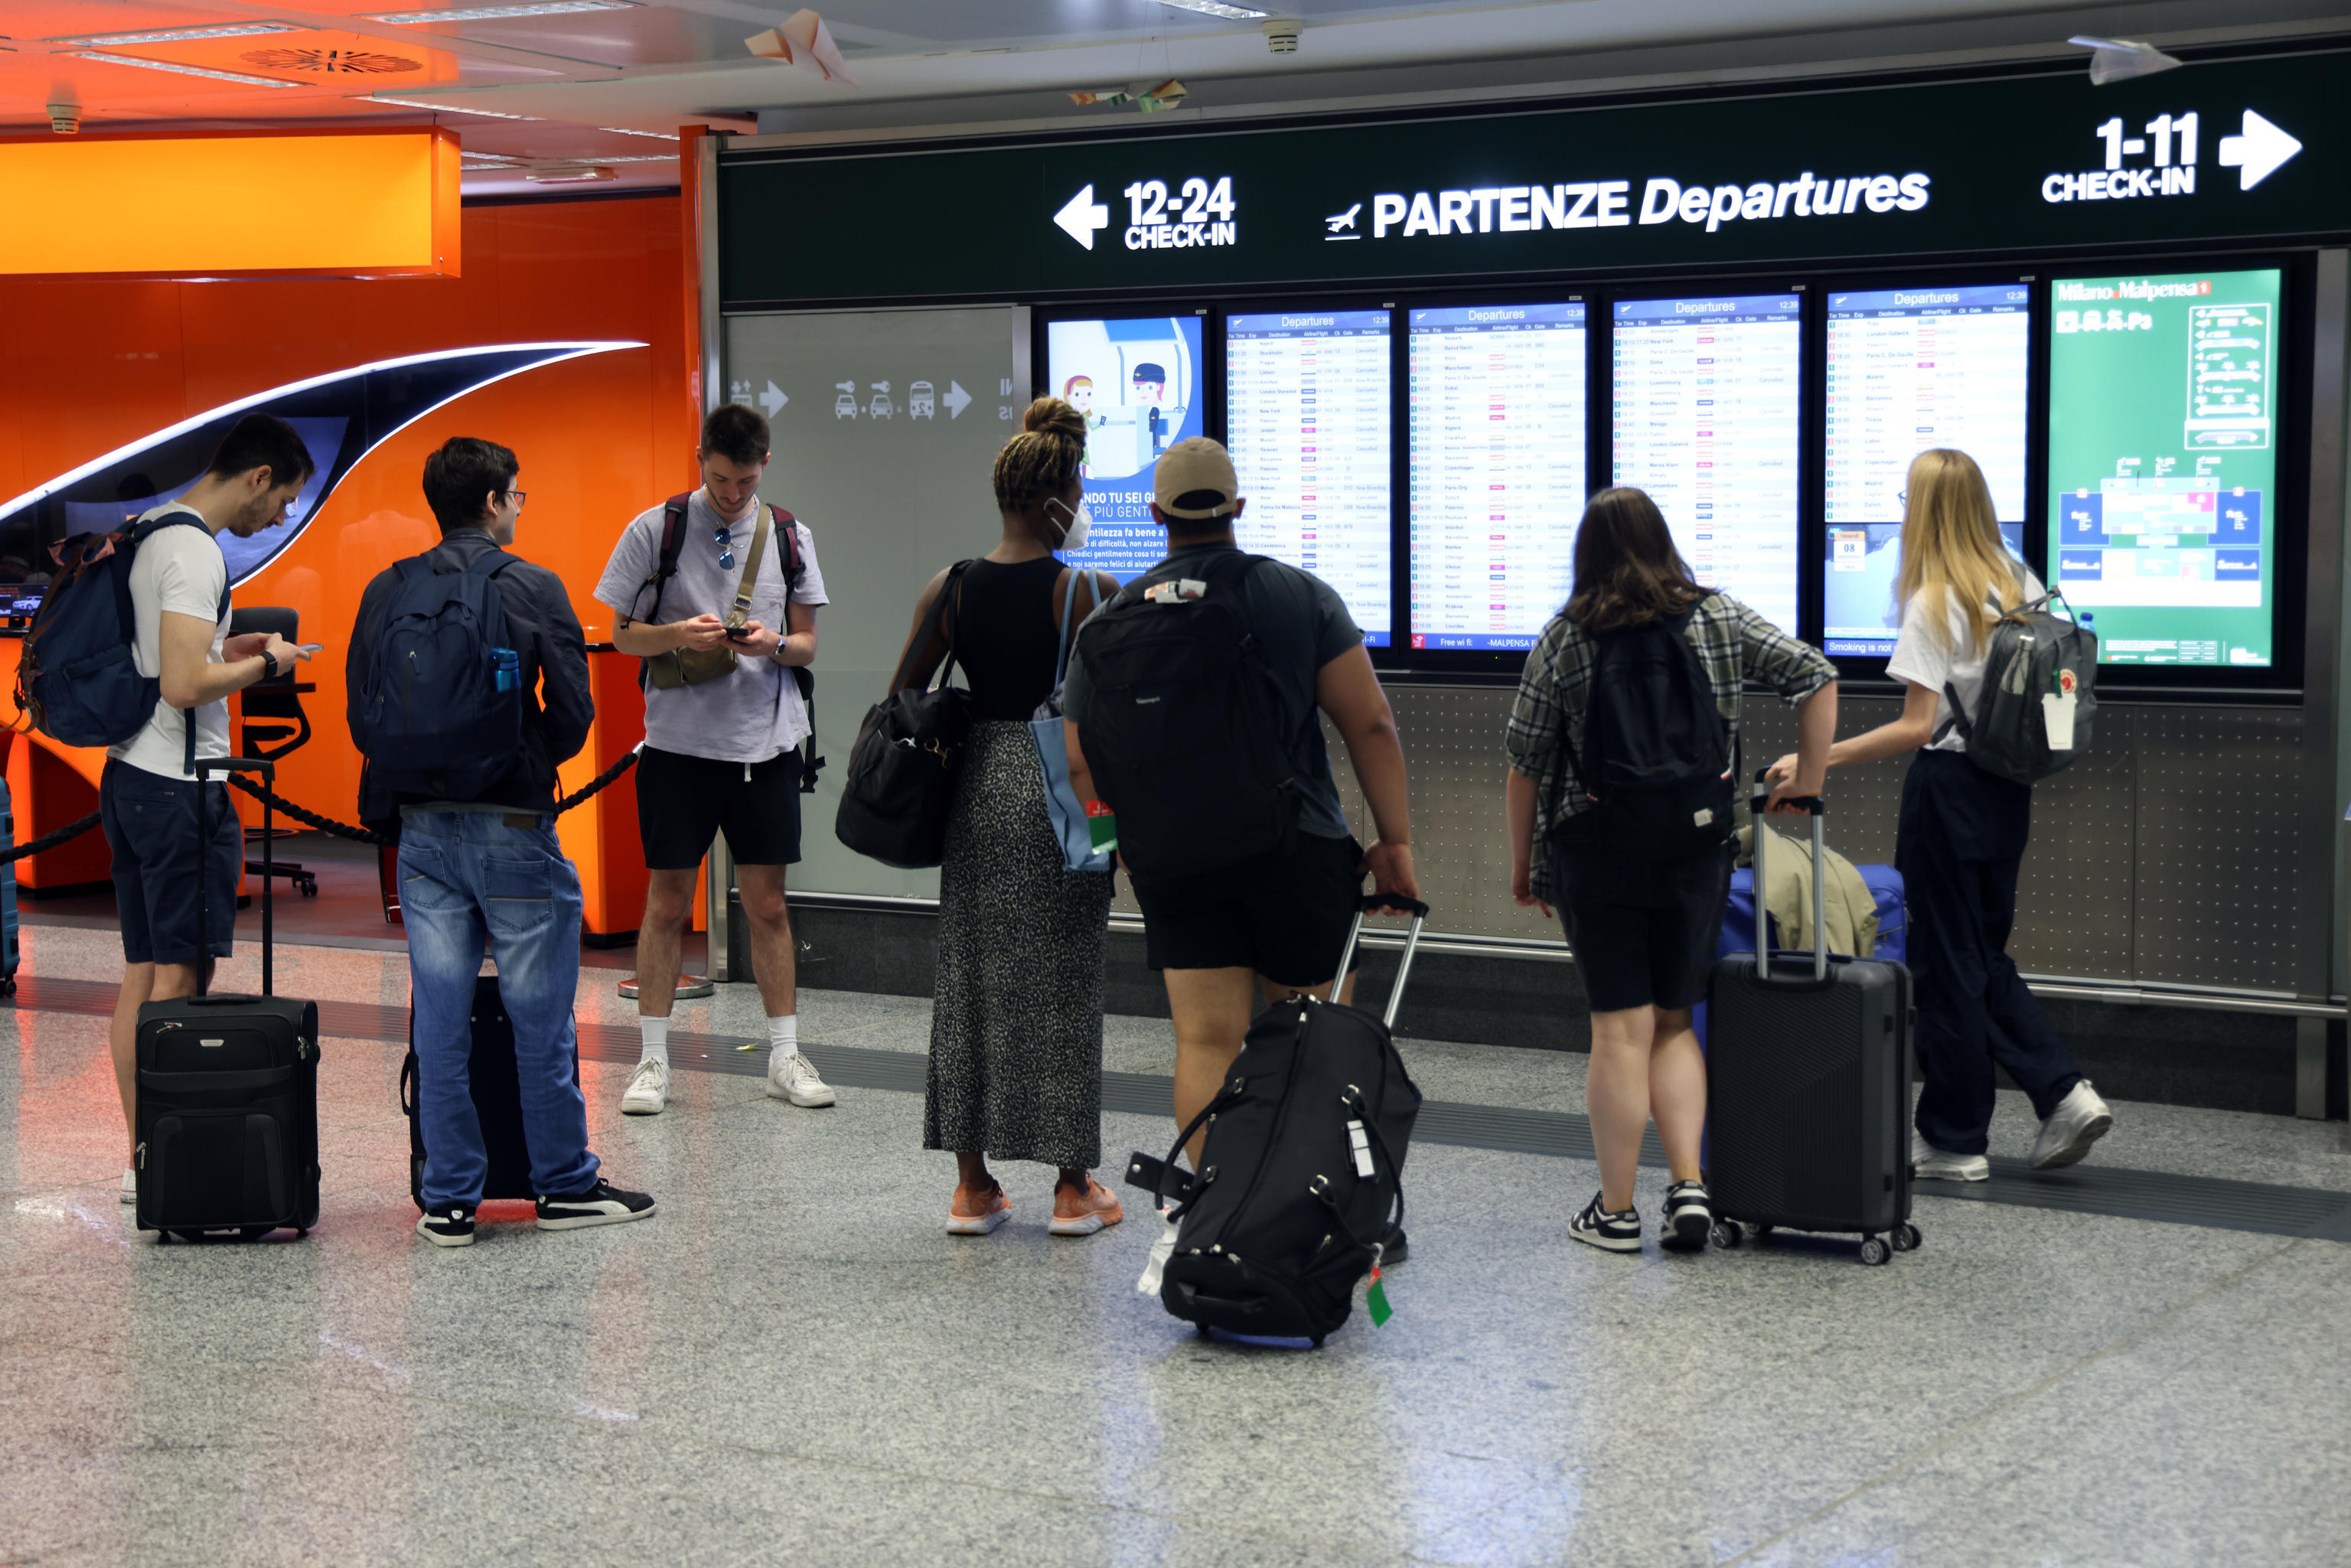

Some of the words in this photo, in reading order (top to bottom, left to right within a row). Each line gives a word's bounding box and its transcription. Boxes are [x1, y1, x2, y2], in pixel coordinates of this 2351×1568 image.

[2095, 111, 2199, 171] 1-11
[2042, 166, 2196, 203] CHECK-IN
[1123, 175, 1235, 226] 12-24
[1374, 181, 1629, 238] PARTENZE
[1639, 171, 1930, 232] Departures
[1123, 223, 1235, 251] CHECK-IN
[2007, 292, 2026, 300] 12:39
[2058, 284, 2112, 301] Milano
[2118, 281, 2198, 302] Malpensa
[1895, 293, 1958, 305] Departures
[1676, 302, 1735, 315] Departures
[1469, 310, 1524, 321] Departures
[2128, 312, 2151, 331] P3
[1282, 317, 1334, 328] Departures
[1109, 493, 1123, 504] TU
[1125, 493, 1141, 504] SEI
[1095, 504, 1113, 517] PIÙ
[1090, 528, 1122, 536] ntilezza
[1125, 528, 1133, 536] fa
[1136, 528, 1156, 536] bene
[1830, 643, 1866, 654] Smoking
[1868, 643, 1875, 651] is
